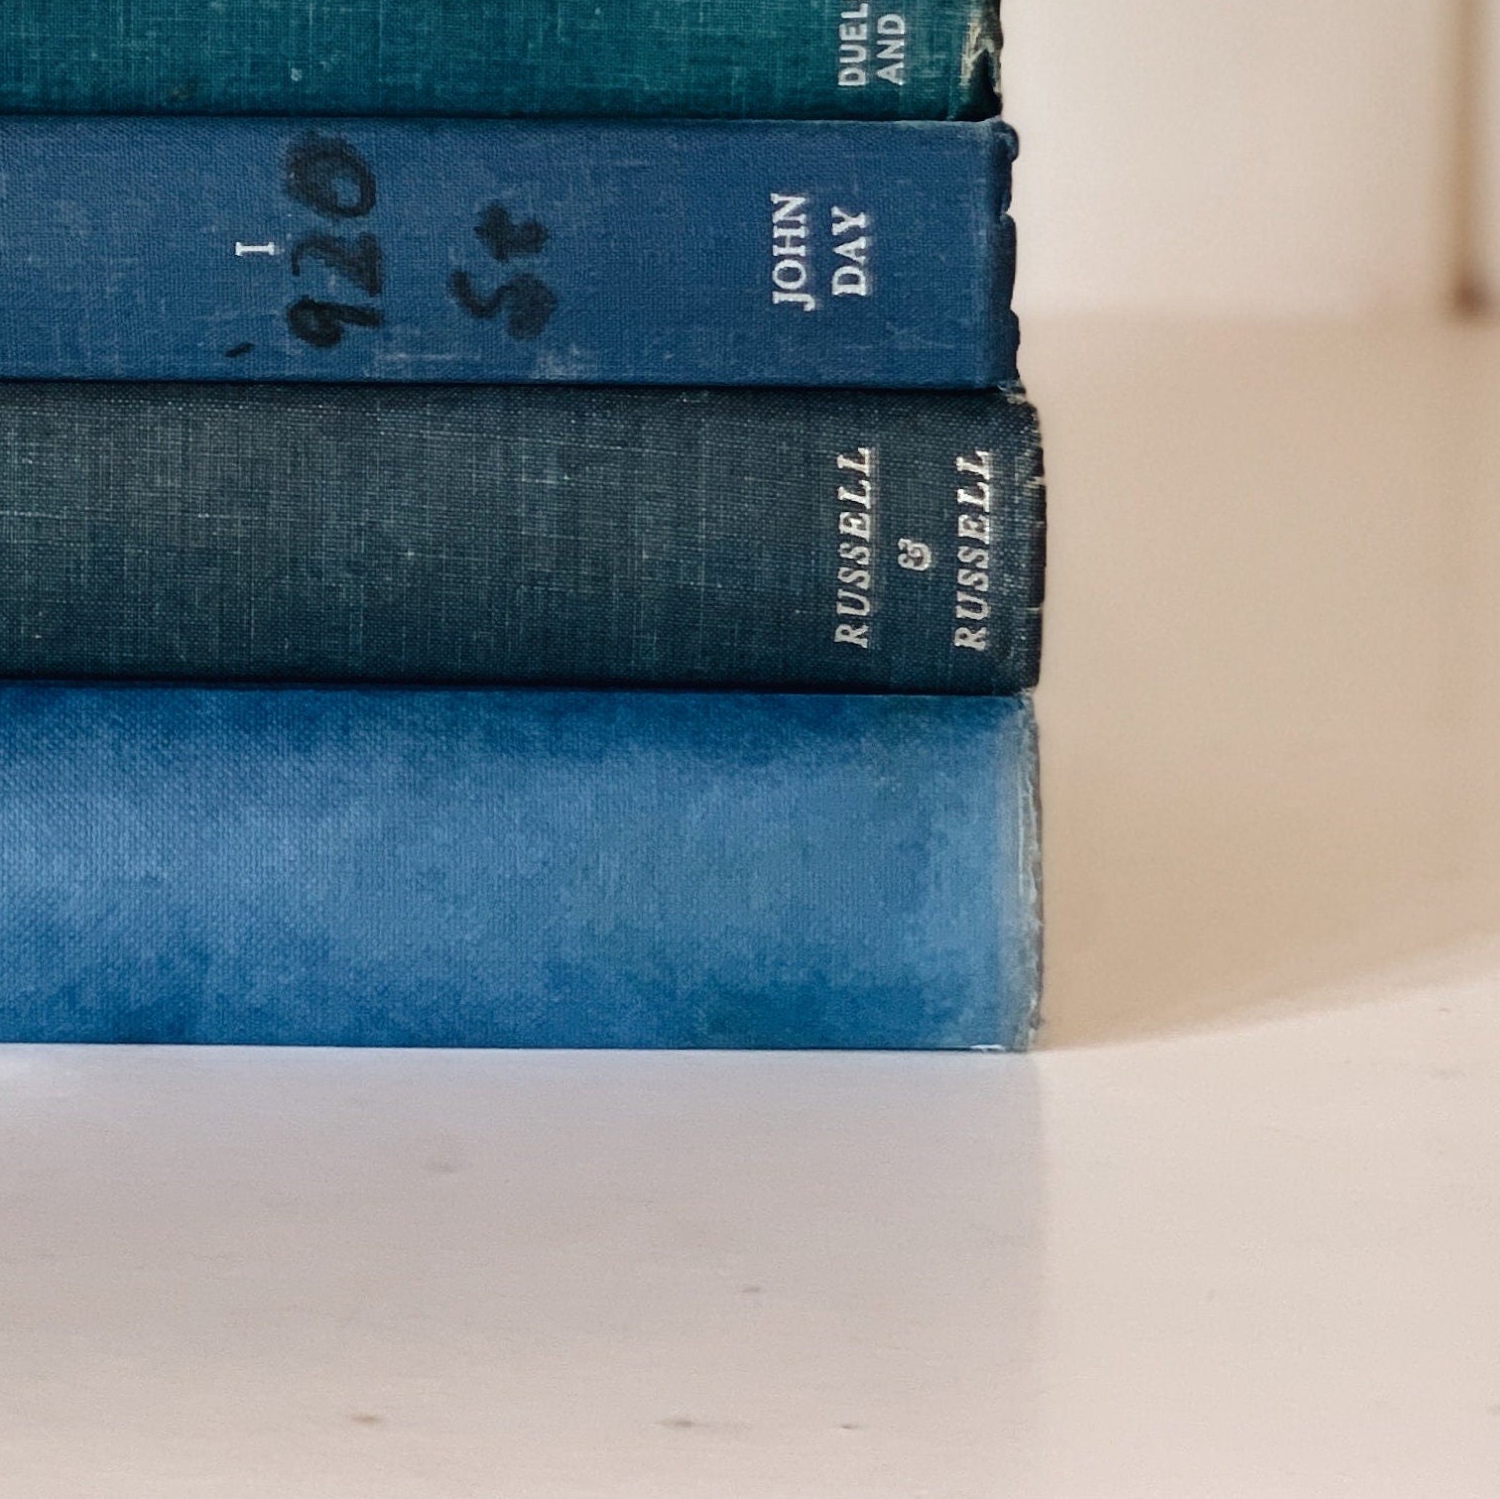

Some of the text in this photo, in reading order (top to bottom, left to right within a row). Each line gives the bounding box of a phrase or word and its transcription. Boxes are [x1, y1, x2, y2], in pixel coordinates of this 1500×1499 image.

[877, 14, 904, 86] AND
[285, 129, 384, 348] 920
[771, 193, 816, 311] JOHN
[832, 207, 869, 297] DAY
[834, 447, 871, 648] RUSSELL
[897, 538, 932, 571] &
[954, 450, 990, 650] RUSSELL
